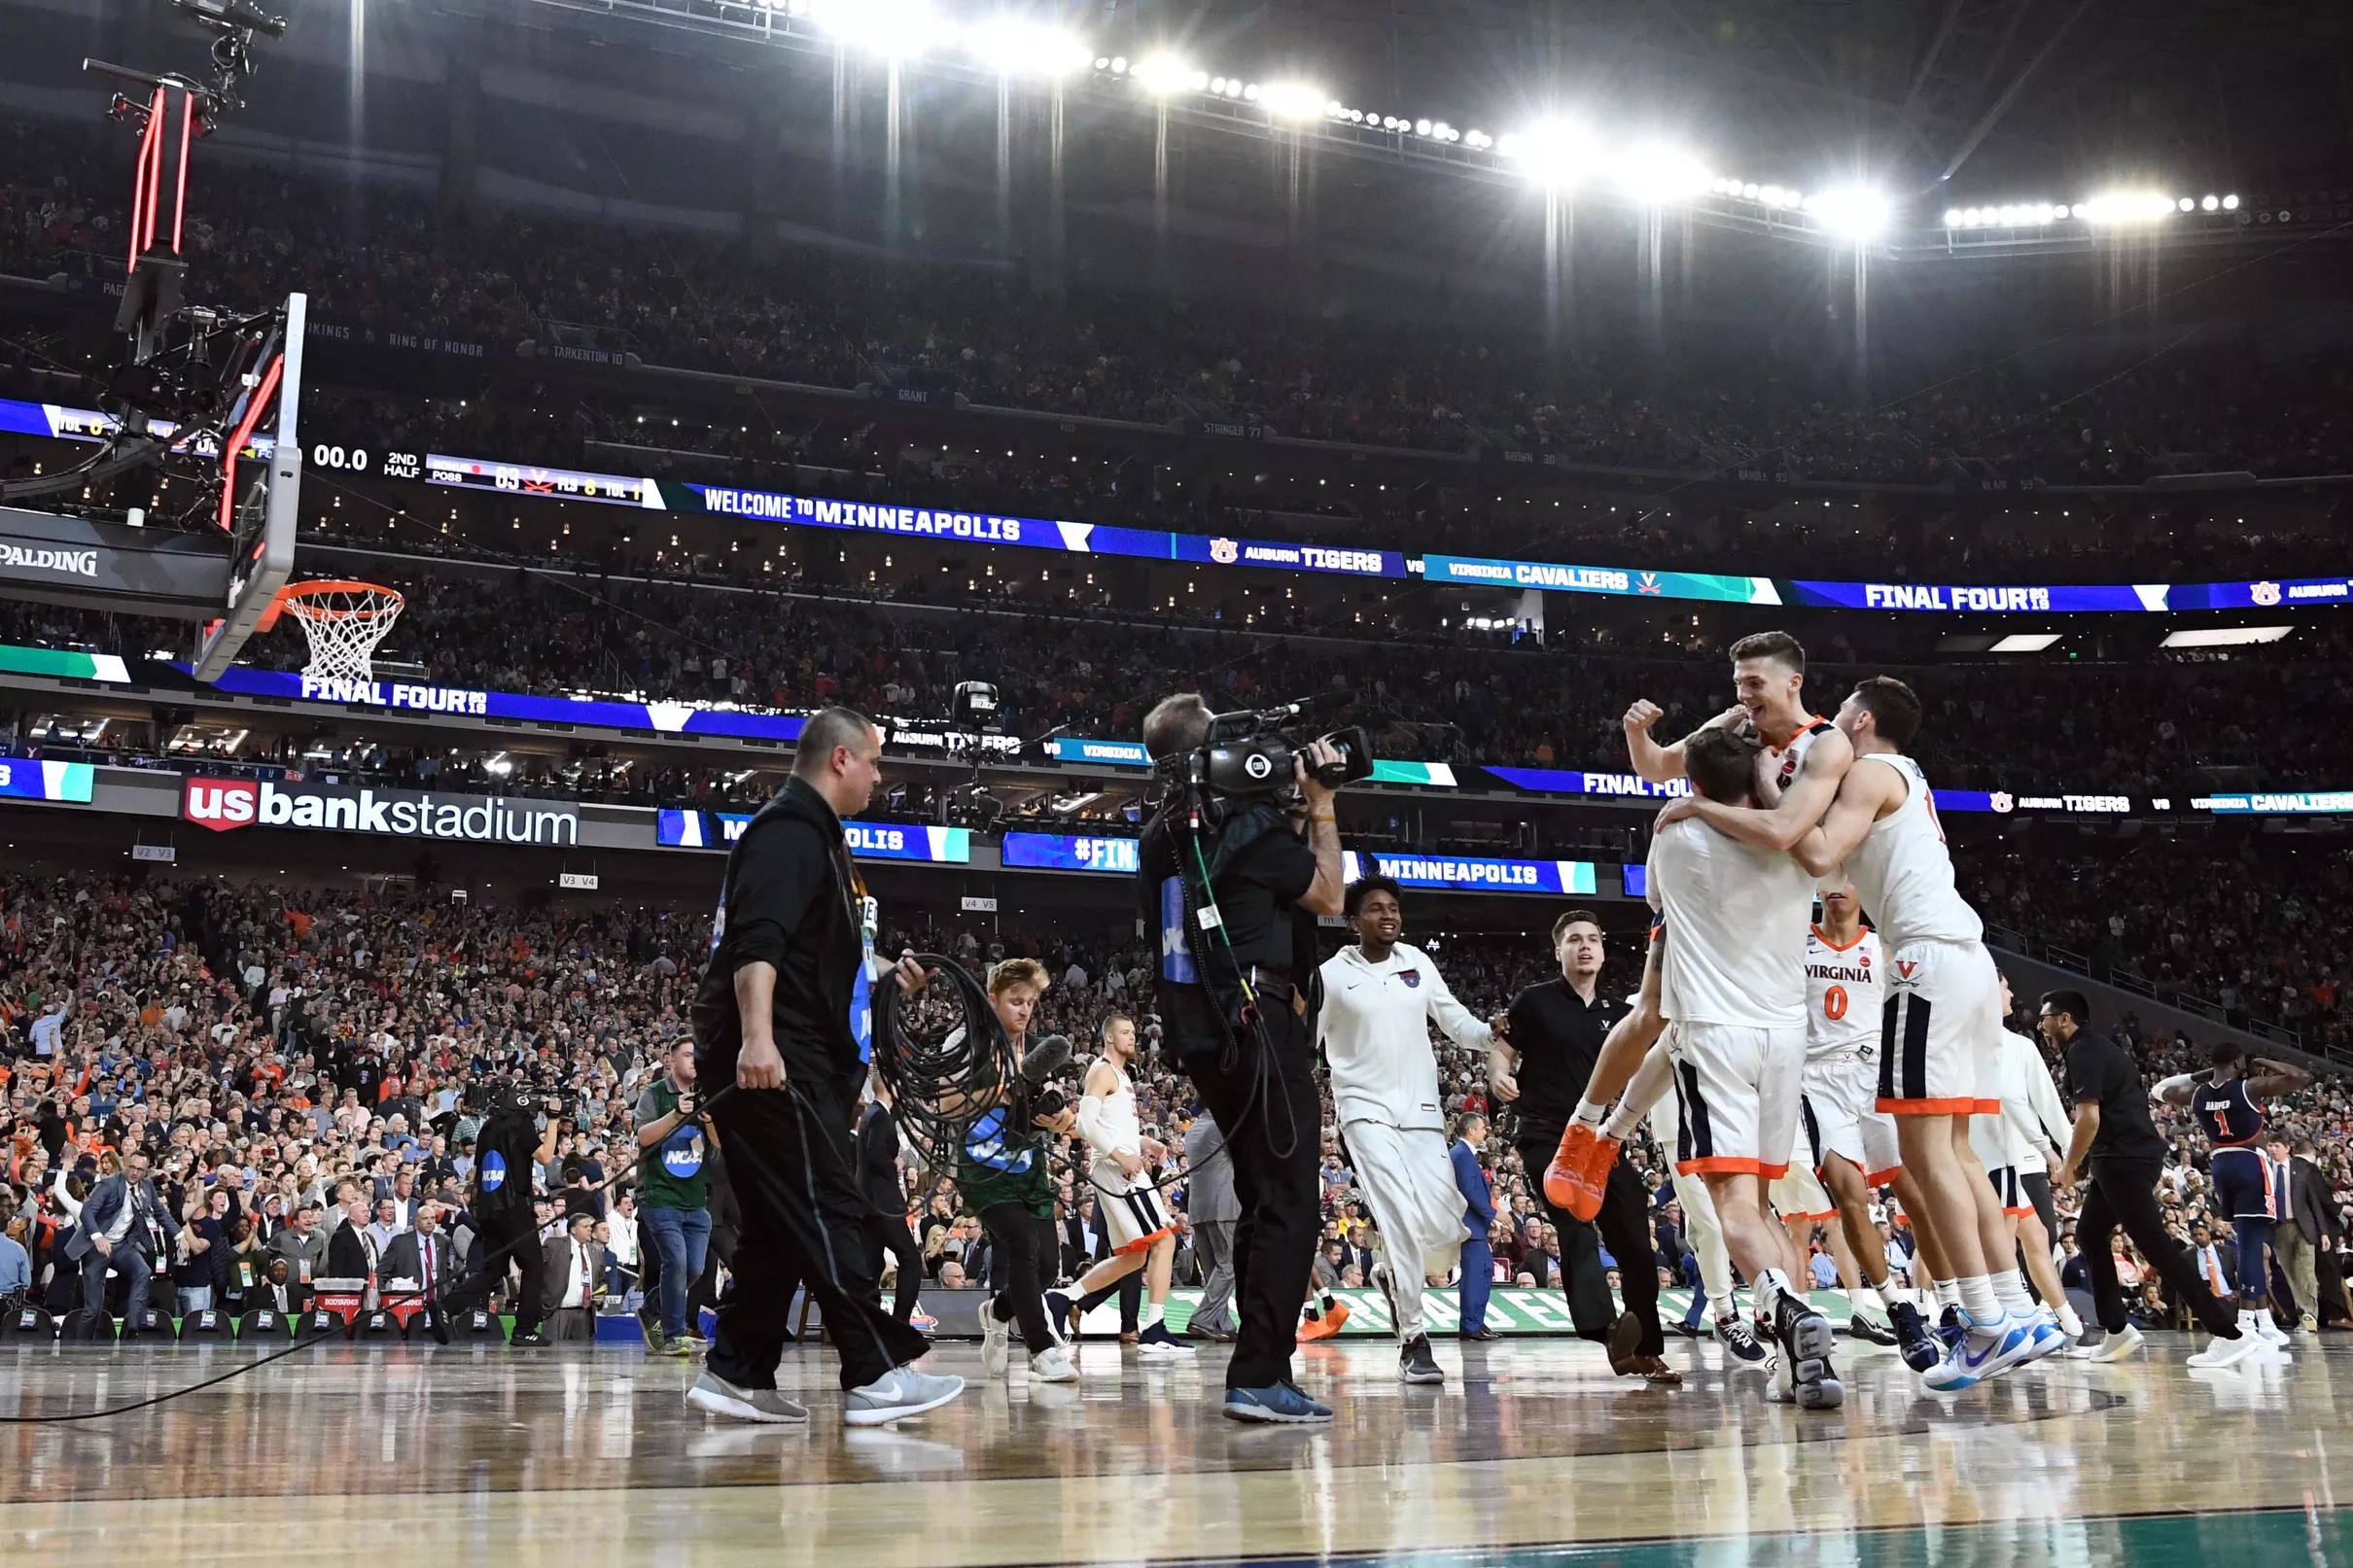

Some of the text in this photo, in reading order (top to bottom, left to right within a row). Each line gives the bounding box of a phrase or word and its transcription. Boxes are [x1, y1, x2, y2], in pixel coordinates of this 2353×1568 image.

[103, 283, 124, 296] PAG
[305, 322, 483, 357] IKINGS RING OF HONOR
[553, 346, 623, 366] TARKENTON 10
[898, 389, 928, 403] GRANT
[1204, 423, 1261, 438] STRINGER 77
[314, 444, 368, 471] 00.0
[388, 452, 417, 467] 2ND
[383, 464, 421, 478] HALF
[705, 488, 1021, 541] WELCOME TO MINNEAPOLIS
[0, 543, 98, 577] PALDING
[1245, 546, 1300, 563] AUBURN
[1300, 547, 1383, 573] TIGERS
[1406, 559, 1425, 574] VS
[1448, 563, 1513, 579] VIRGINIA
[1515, 565, 1629, 590] CAVALIERS
[1865, 584, 1948, 610] FINAL
[1950, 586, 2029, 610] FOUR
[2288, 583, 2348, 599] AUBURN
[301, 676, 387, 705] FINAL
[392, 683, 467, 713] FOUR
[892, 731, 943, 747] AUBURN
[1082, 745, 1142, 760] VIRGINIA
[1583, 773, 1695, 798] FINAL FOU
[2018, 797, 2063, 809] AUBURN
[2062, 794, 2130, 813] TIGERS
[2190, 797, 2249, 810] VIRGINIA
[136, 847, 171, 858] V2 V3
[563, 875, 595, 887] V3 V4
[1379, 858, 1537, 885] MINNEAPOLIS
[965, 899, 995, 909] V4 V5
[1805, 964, 1873, 984] VIRGINIA
[1824, 985, 1848, 1022] 0
[2214, 1110, 2234, 1136] 1
[481, 1169, 505, 1182] NCAA
